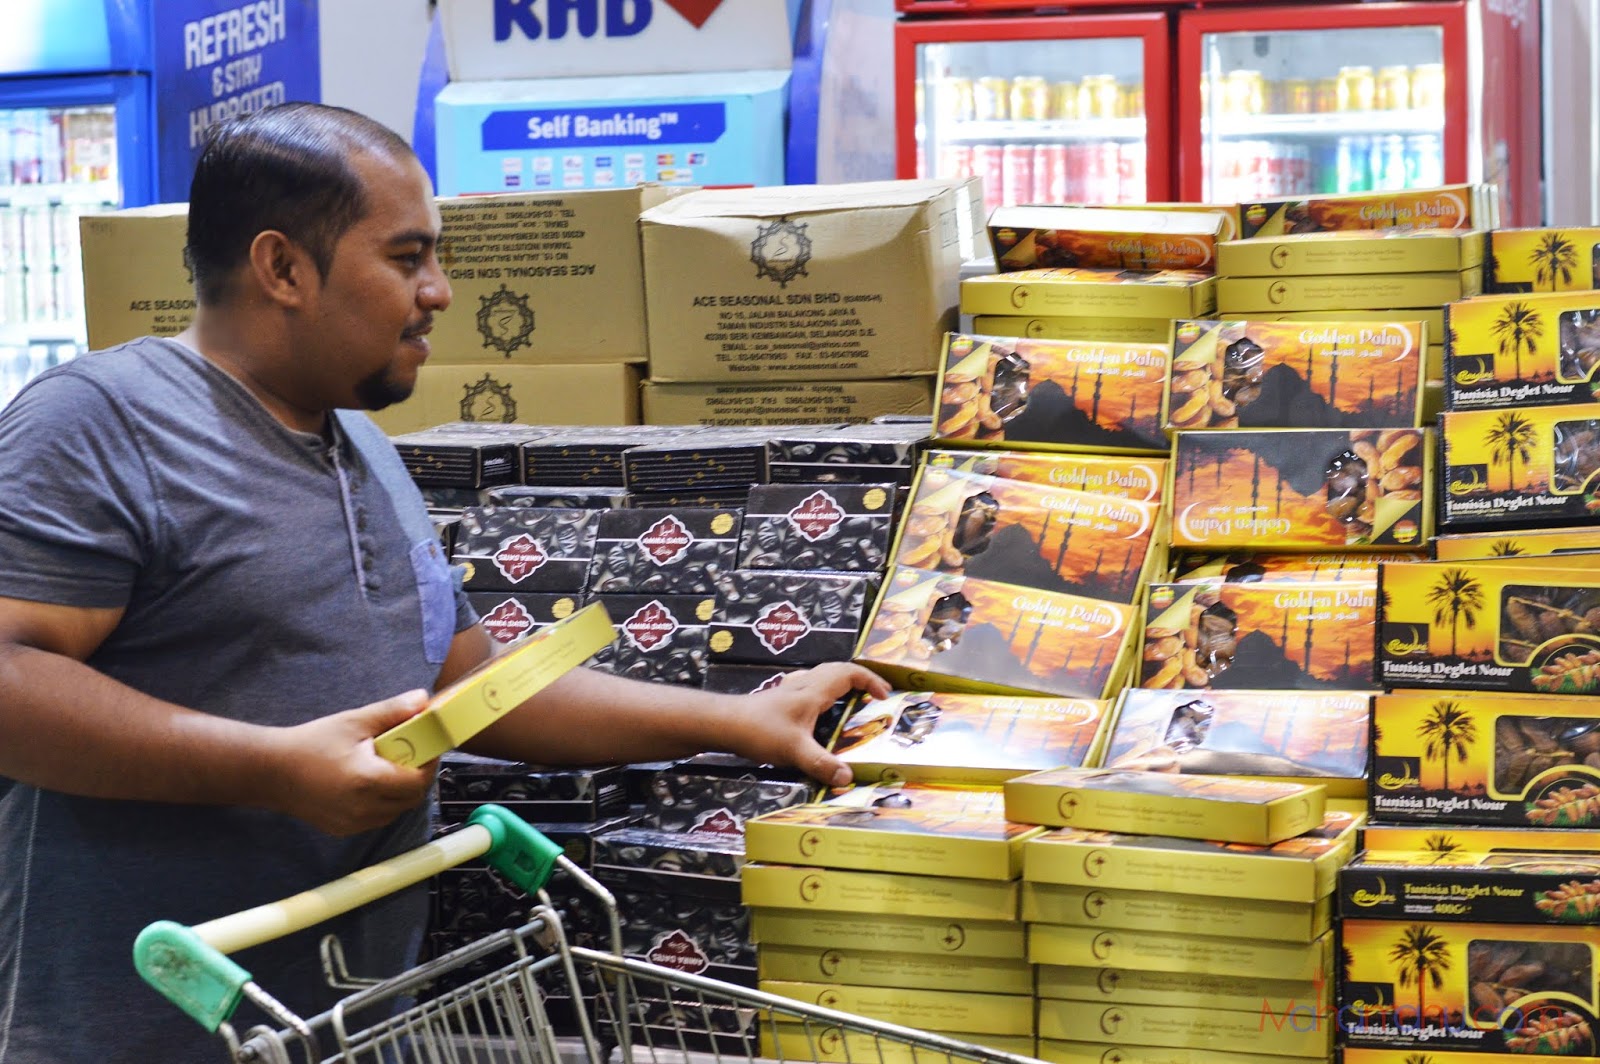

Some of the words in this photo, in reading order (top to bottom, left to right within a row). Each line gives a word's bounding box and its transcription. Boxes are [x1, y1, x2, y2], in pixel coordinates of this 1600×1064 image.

[184, 0, 286, 70] REFRESH
[212, 66, 223, 97] &
[225, 53, 262, 93] STAY
[527, 115, 571, 139] Self
[1360, 203, 1412, 220] Golden
[1415, 200, 1456, 217] Palm
[1107, 240, 1159, 254] Golden
[1161, 241, 1201, 255] Palm
[450, 268, 474, 279] BHD
[477, 268, 501, 278] SDN
[505, 266, 568, 277] SEASONAL
[571, 264, 597, 276] ACE
[130, 301, 152, 311] ACE
[693, 296, 717, 307] ACE
[719, 295, 784, 306] SEASONAL
[786, 294, 812, 305] SDN
[814, 293, 840, 304] BHD
[1299, 328, 1355, 344] Golden
[1359, 328, 1402, 345] Palm
[1066, 348, 1121, 363] Golden
[1123, 350, 1165, 366] Palm
[1452, 387, 1499, 401] Tunisia
[1500, 384, 1541, 400] Deglet
[1542, 384, 1575, 395] Nour
[1049, 467, 1103, 485] Golden
[1106, 470, 1148, 488] Palm
[1040, 495, 1095, 517] Golden
[1097, 503, 1139, 524] Palm
[1446, 498, 1492, 511] Tunisia
[1493, 495, 1535, 511] Deglet
[1535, 495, 1568, 506] Nour
[1190, 518, 1231, 536] Palm
[1234, 517, 1291, 536] Golden
[1274, 592, 1331, 608] Golden
[1012, 595, 1067, 617] Golden
[1069, 604, 1112, 625] Palm
[1382, 661, 1432, 673] Tunisia
[1433, 662, 1477, 679] Deglet
[1478, 664, 1514, 677] Nour
[1373, 795, 1424, 808] Tunisia
[1425, 796, 1470, 813] Deglet
[1471, 798, 1508, 811] Nour
[1403, 883, 1449, 895] Tunisia
[1451, 884, 1490, 898] Deglet
[1491, 886, 1526, 897] Nour
[1346, 1022, 1398, 1035] Tunisia
[1400, 1024, 1447, 1041] Deglet
[1449, 1026, 1486, 1039] Nour
